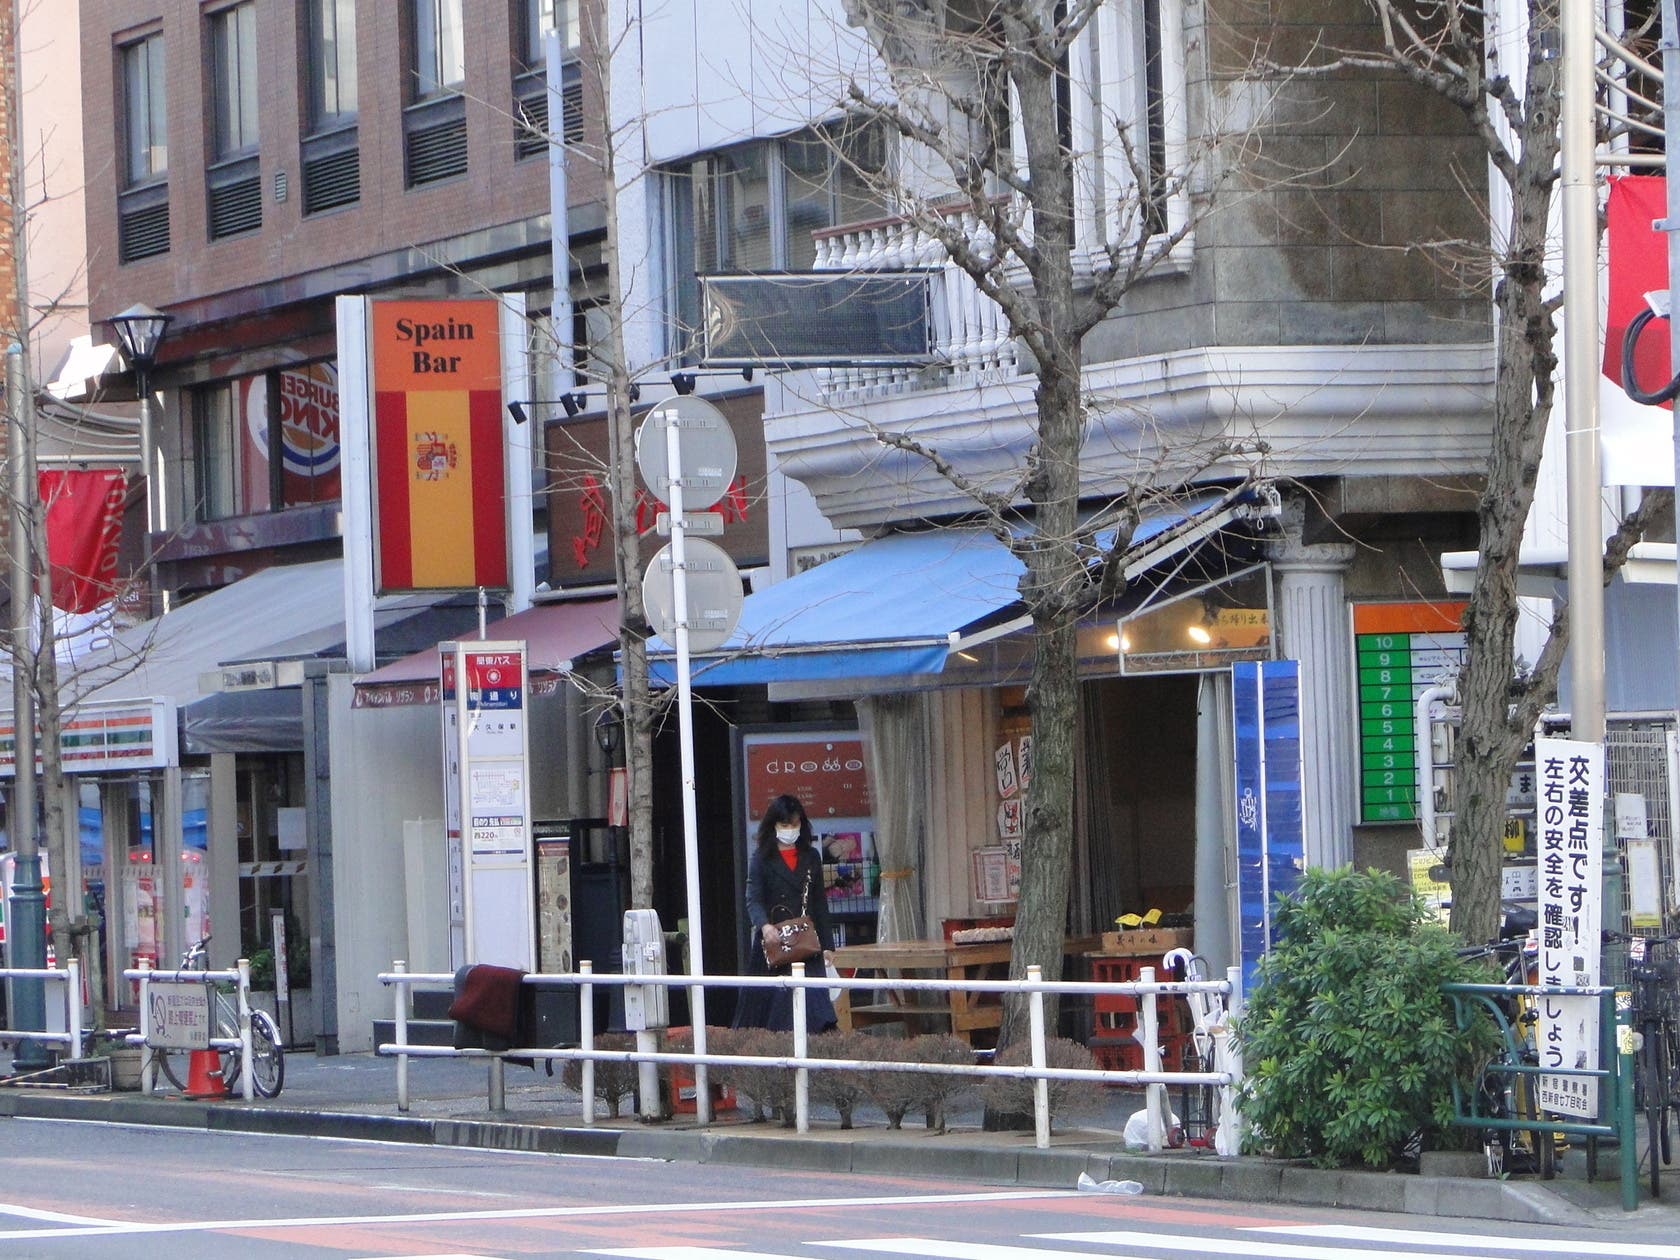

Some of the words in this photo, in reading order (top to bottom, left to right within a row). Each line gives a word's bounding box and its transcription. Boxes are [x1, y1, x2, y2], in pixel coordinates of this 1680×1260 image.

[395, 317, 475, 347] Spain
[413, 351, 462, 374] Bar
[101, 473, 129, 573] TOKYO
[1376, 637, 1393, 649] 10
[1379, 653, 1390, 665] 9
[1381, 670, 1391, 682] 8
[1381, 687, 1391, 699] 7
[1382, 704, 1392, 716] 6
[1383, 721, 1393, 733] 5
[1383, 738, 1394, 750] 4
[1383, 755, 1394, 767] 3
[1383, 772, 1394, 784] 2
[1386, 789, 1393, 801] 1
[1567, 755, 1590, 945] 交差点です!
[1543, 757, 1565, 1068] 左右の安全を確認しましょう
